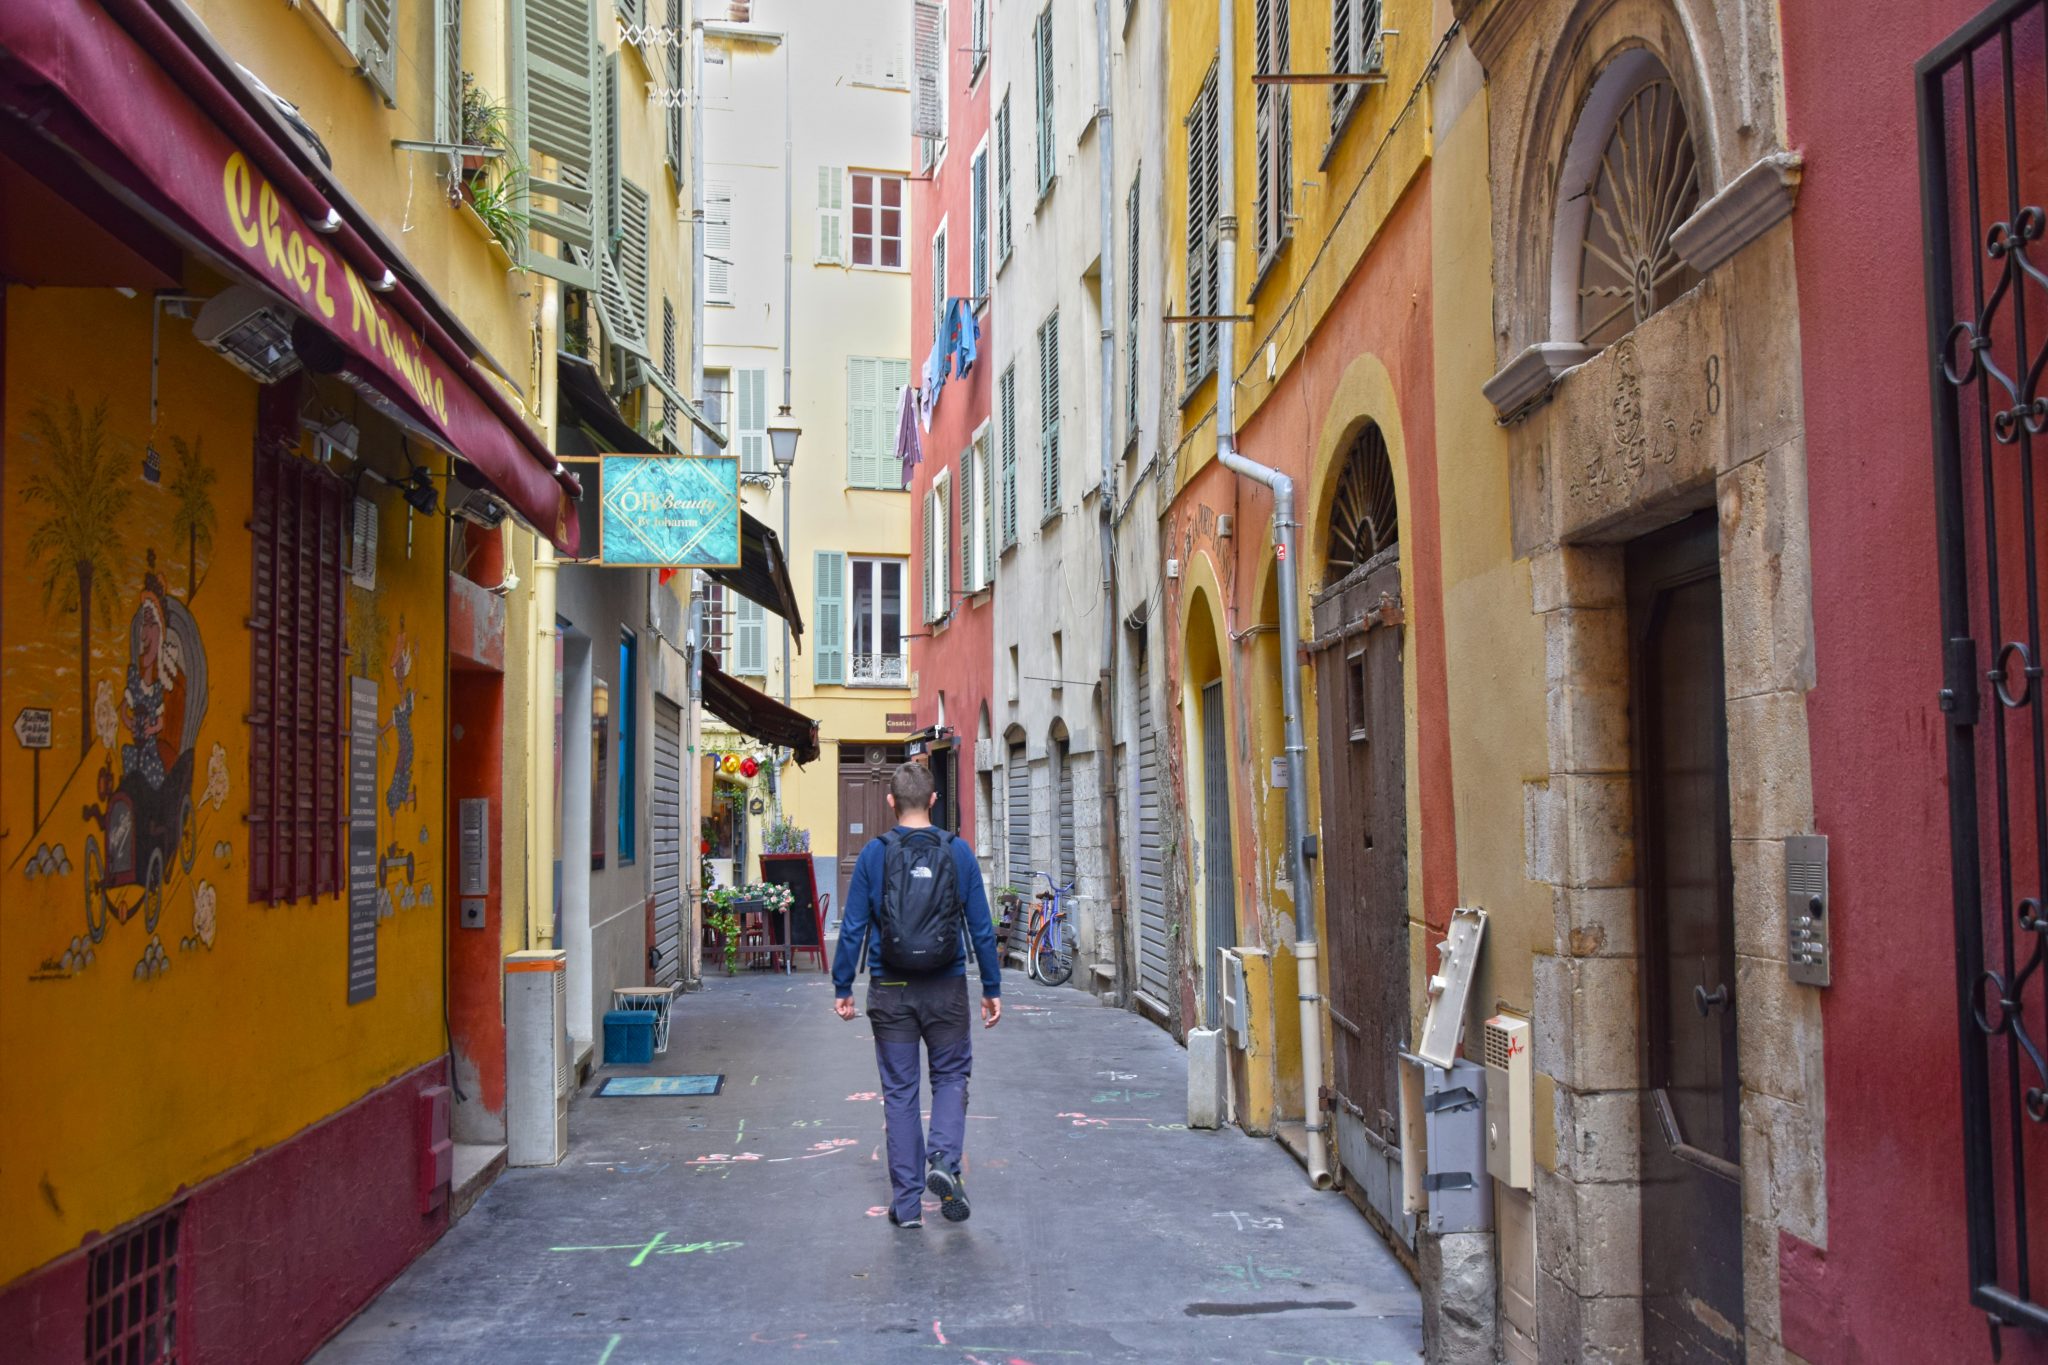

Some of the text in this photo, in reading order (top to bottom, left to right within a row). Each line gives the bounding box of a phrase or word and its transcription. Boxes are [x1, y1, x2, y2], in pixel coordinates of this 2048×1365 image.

[224, 151, 335, 318] Chez
[1706, 354, 1720, 415] 8
[658, 491, 716, 515] Beauty
[1198, 502, 1214, 542] PORTE
[872, 751, 880, 760] 6
